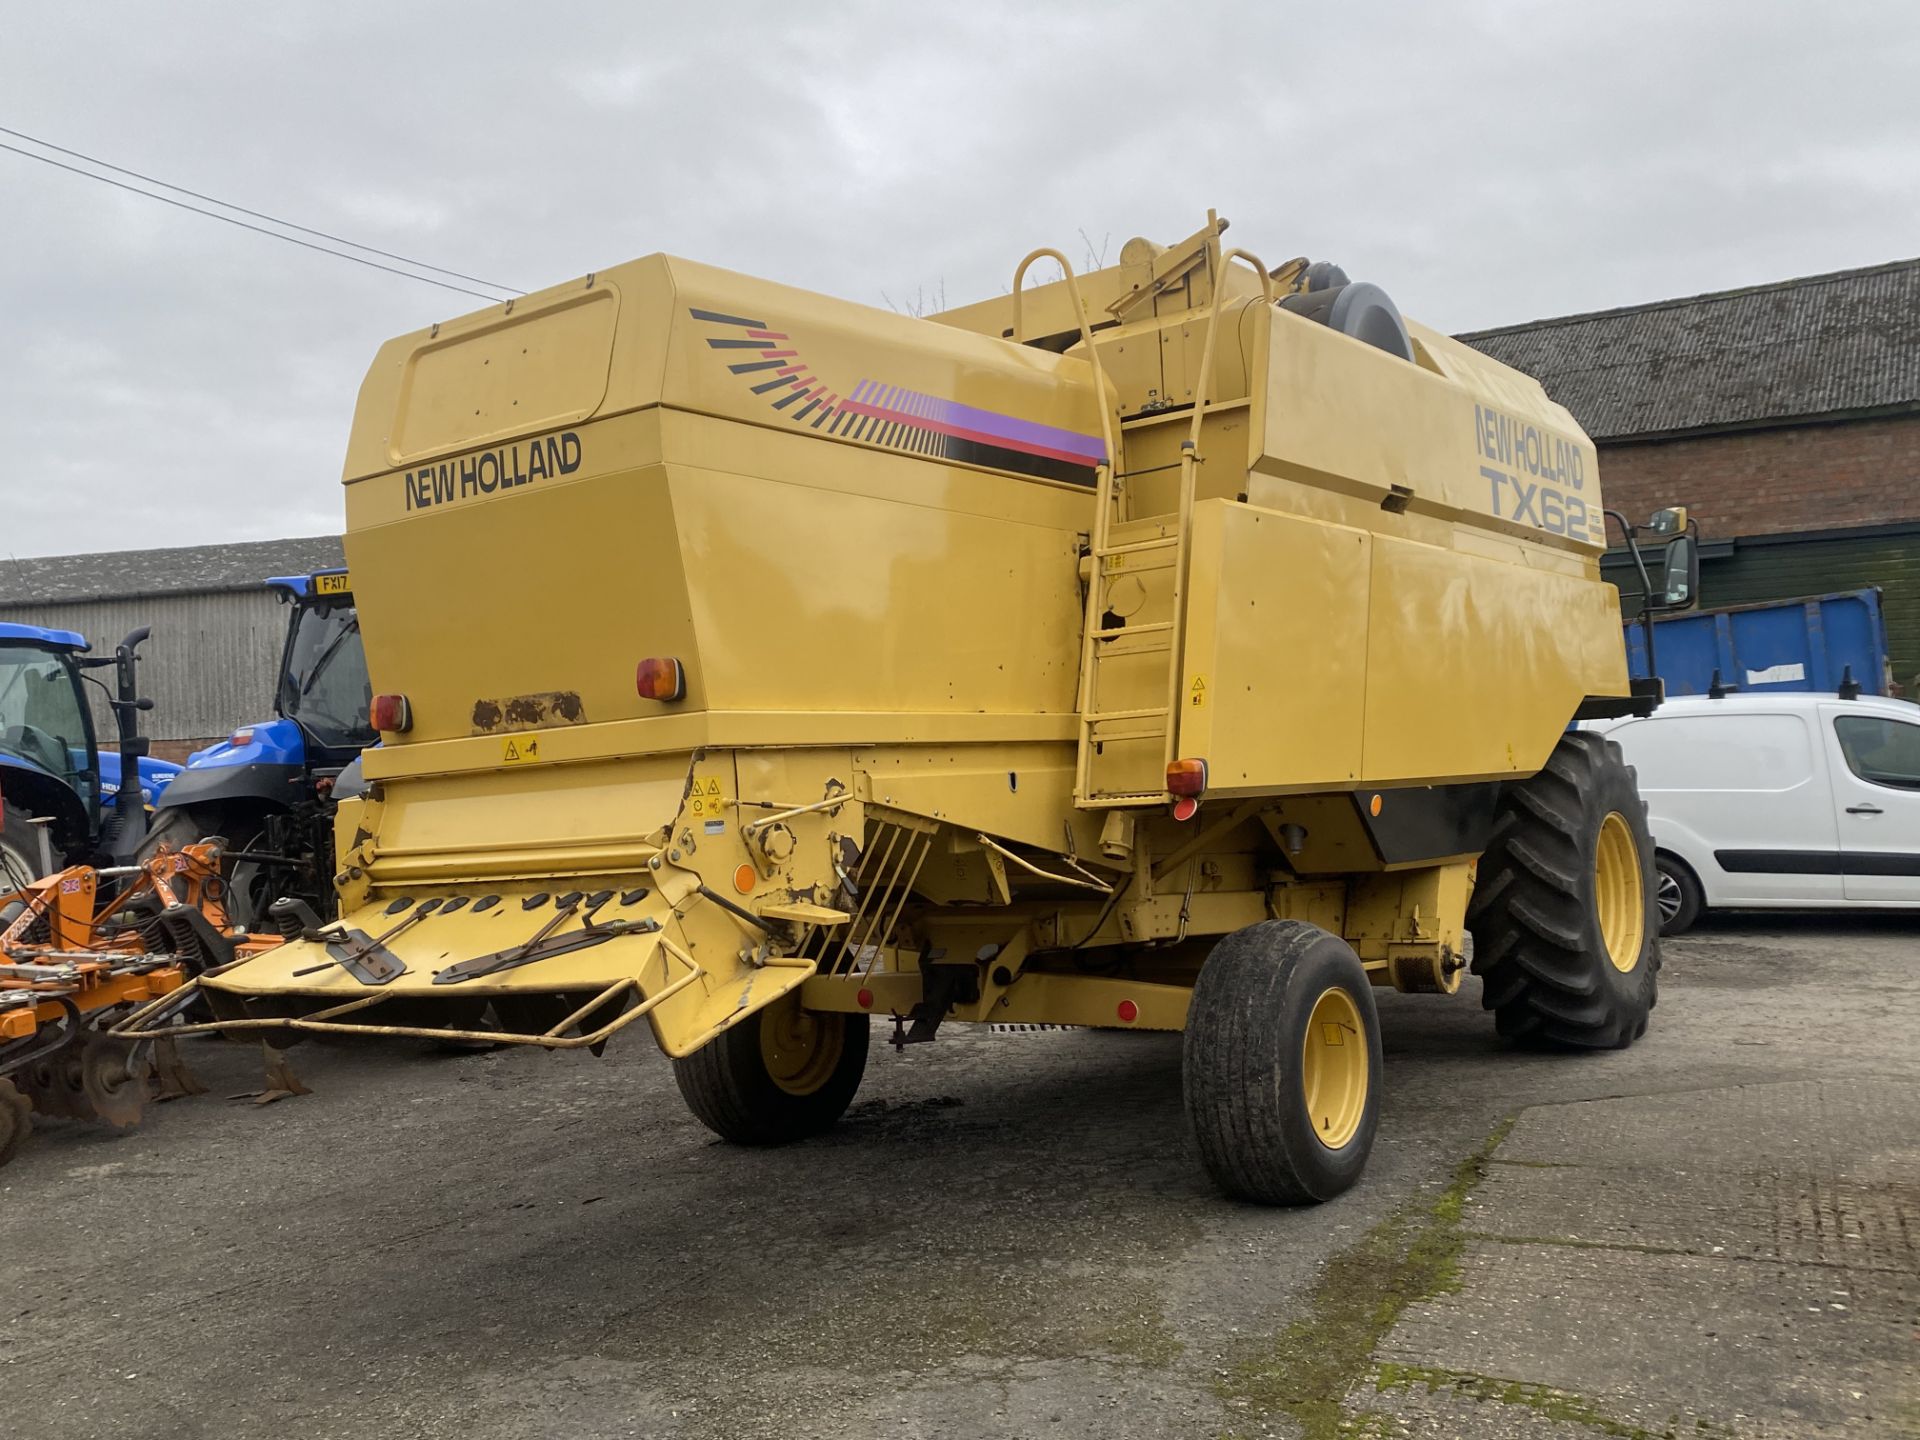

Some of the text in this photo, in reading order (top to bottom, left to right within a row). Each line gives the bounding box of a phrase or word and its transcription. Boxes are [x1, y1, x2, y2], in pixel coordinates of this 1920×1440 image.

[405, 432, 582, 511] NEW HOLLAND
[1475, 404, 1584, 490] NEW HOLLAND
[1479, 465, 1590, 542] TX62
[323, 575, 347, 592] FX17
